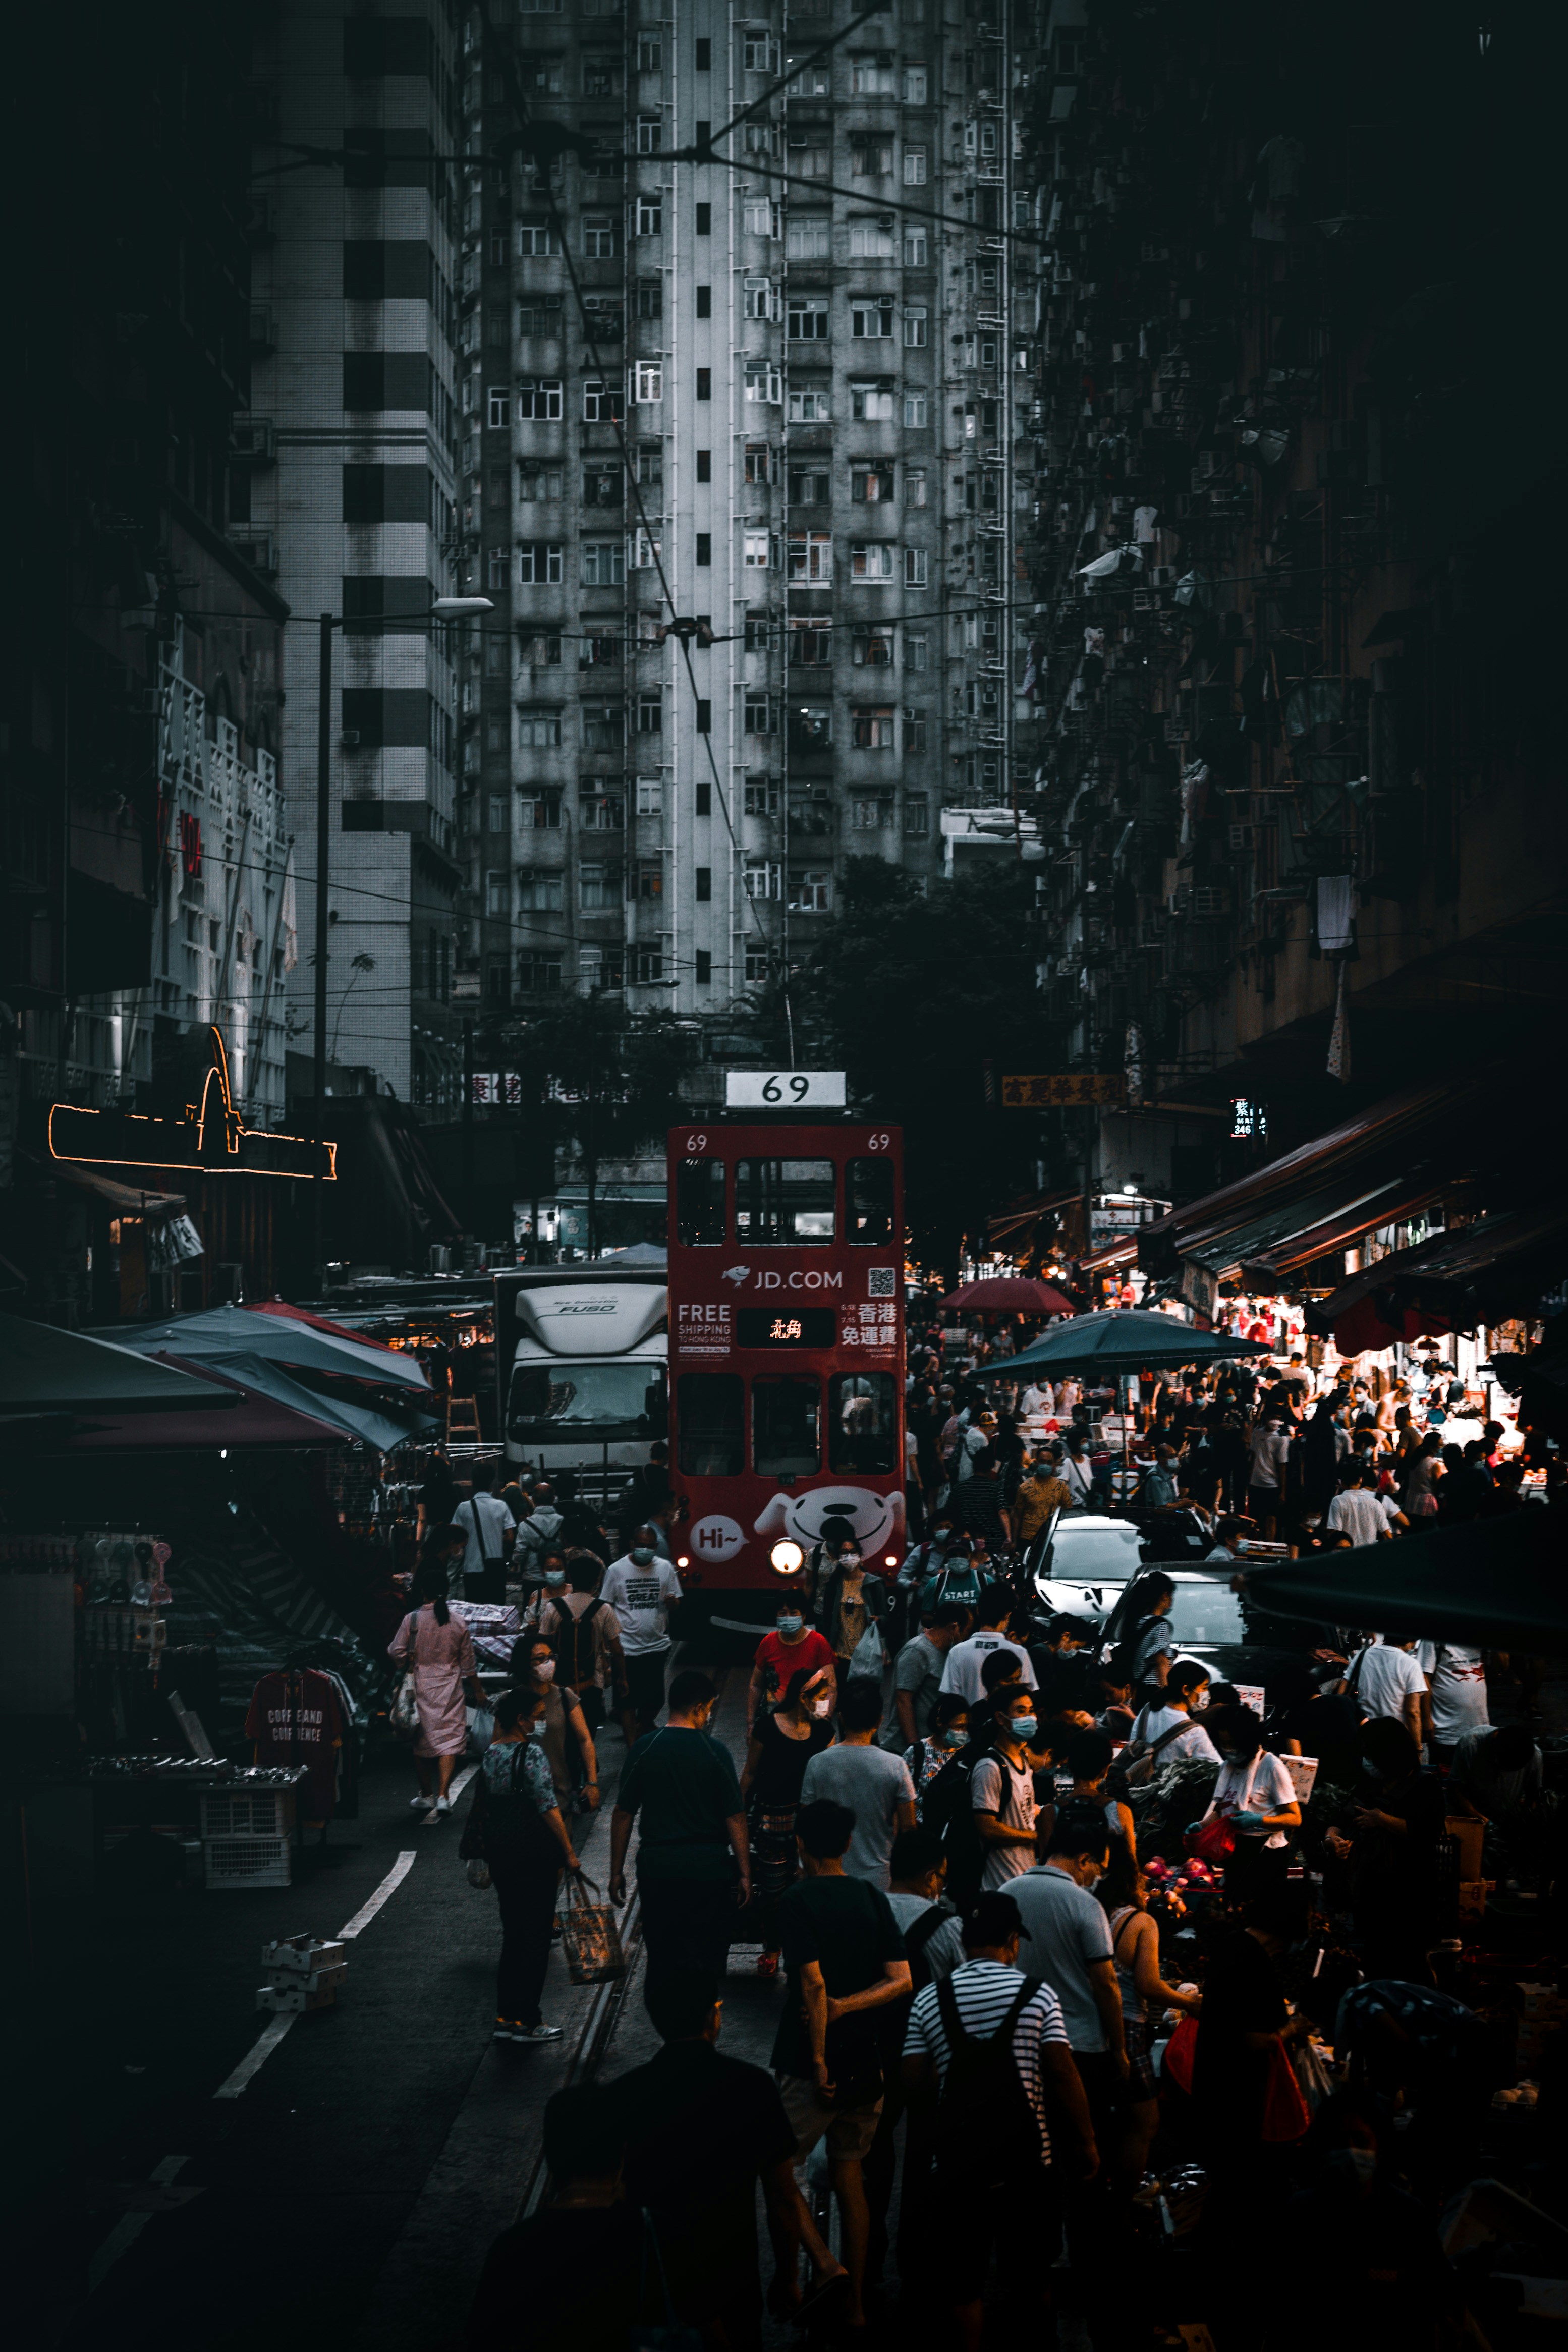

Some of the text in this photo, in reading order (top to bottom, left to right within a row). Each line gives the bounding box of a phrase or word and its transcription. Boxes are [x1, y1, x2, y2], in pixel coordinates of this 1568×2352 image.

[762, 1075, 810, 1103] 69
[686, 1134, 707, 1152] 69
[867, 1134, 890, 1151] 69
[754, 1270, 843, 1290] JD.COM
[678, 1304, 731, 1322] FREE
[858, 1303, 897, 1323] 香港
[678, 1325, 731, 1335] SHIPPING
[769, 1319, 802, 1339] 北角
[841, 1325, 897, 1346] 免運費
[678, 1335, 731, 1343] TO HONG KONG
[628, 1593, 660, 1602] GREAT
[944, 1590, 975, 1599] START
[303, 1709, 323, 1724] AND
